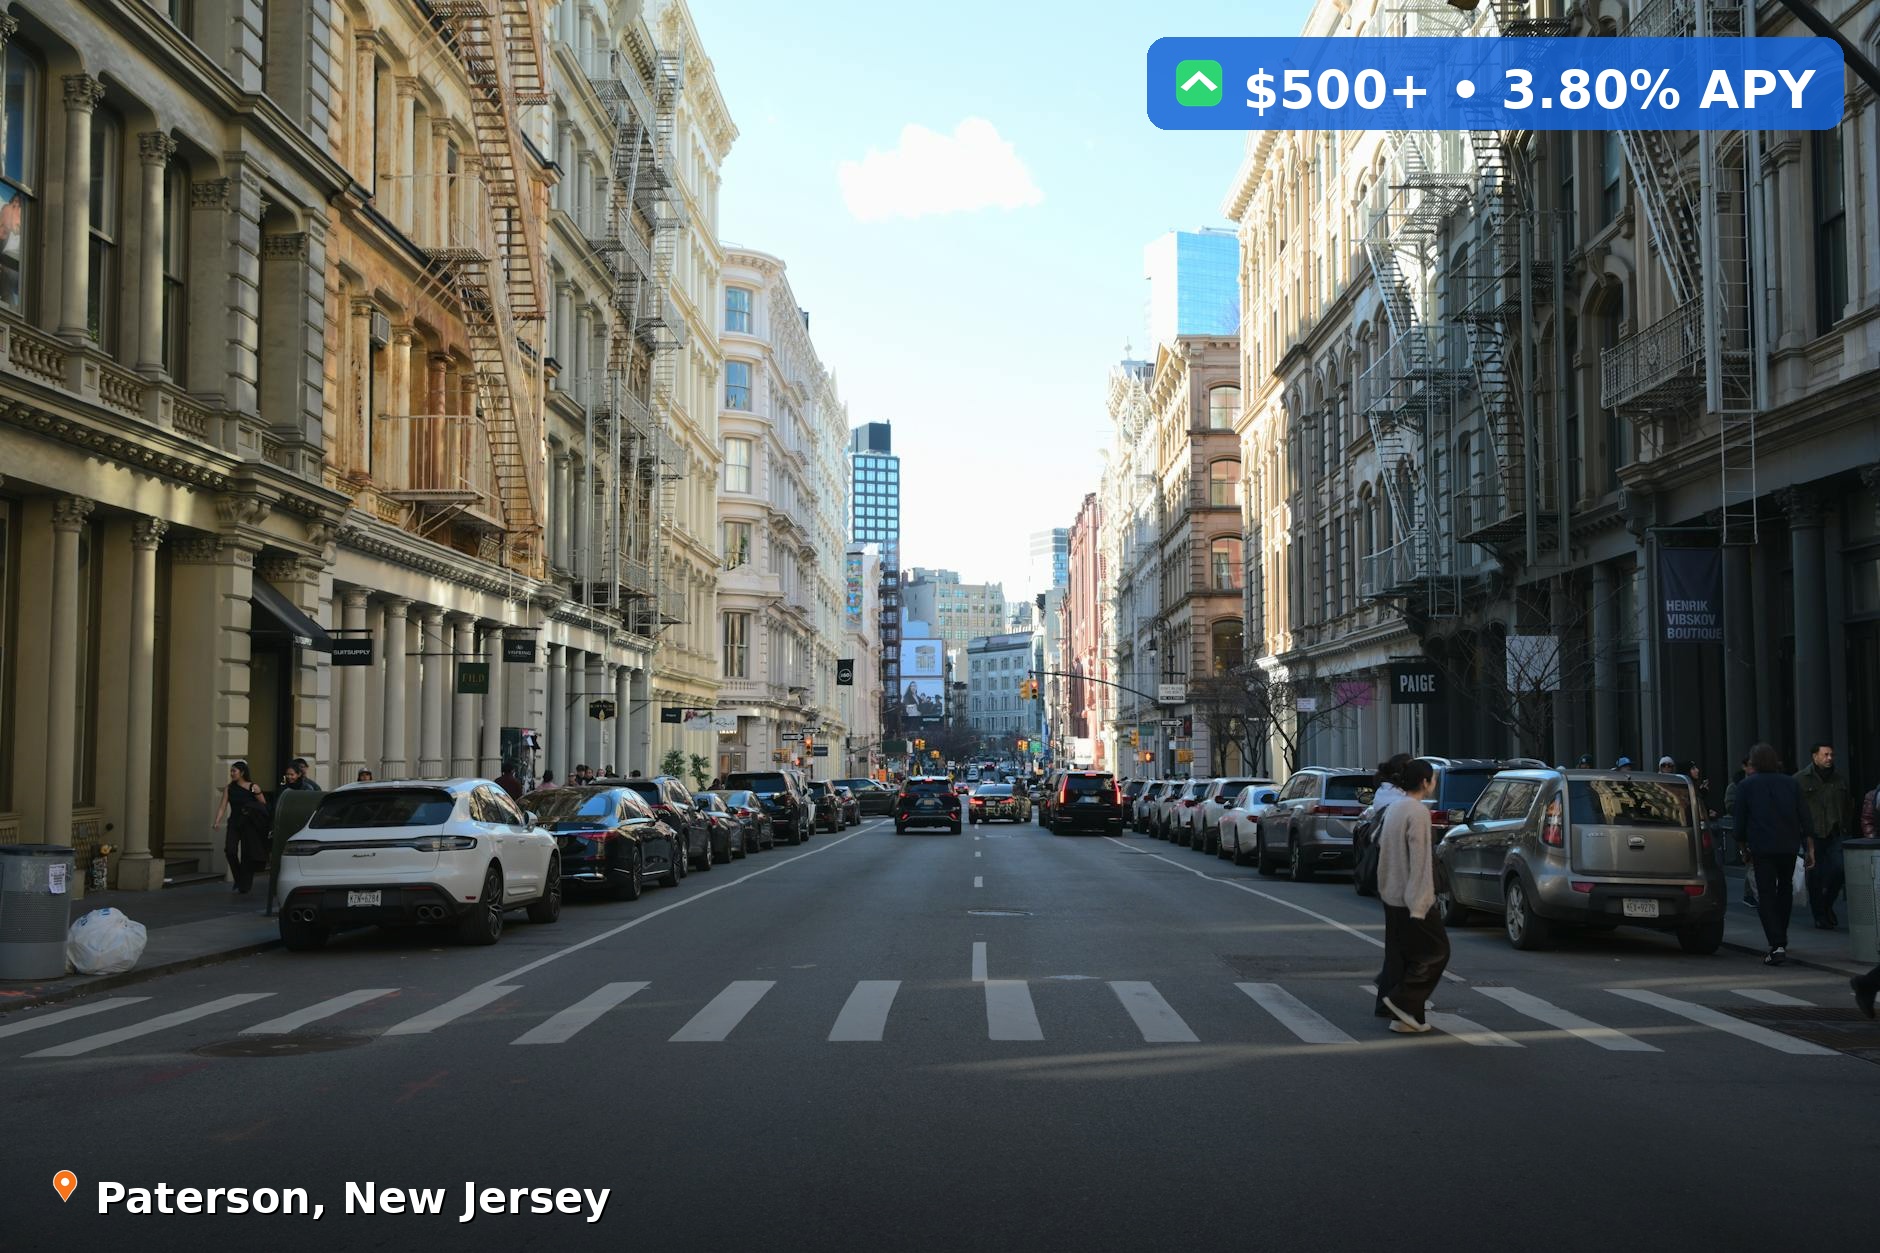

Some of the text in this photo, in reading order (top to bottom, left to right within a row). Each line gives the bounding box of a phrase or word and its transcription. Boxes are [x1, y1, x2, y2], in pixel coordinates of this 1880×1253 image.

[1666, 600, 1709, 612] HENRIK
[1667, 613, 1716, 626] VIBSKOV
[1667, 627, 1723, 640] BOUTIQUE
[333, 648, 371, 656] SUITSUPPLY
[1400, 674, 1436, 693] PAIGE
